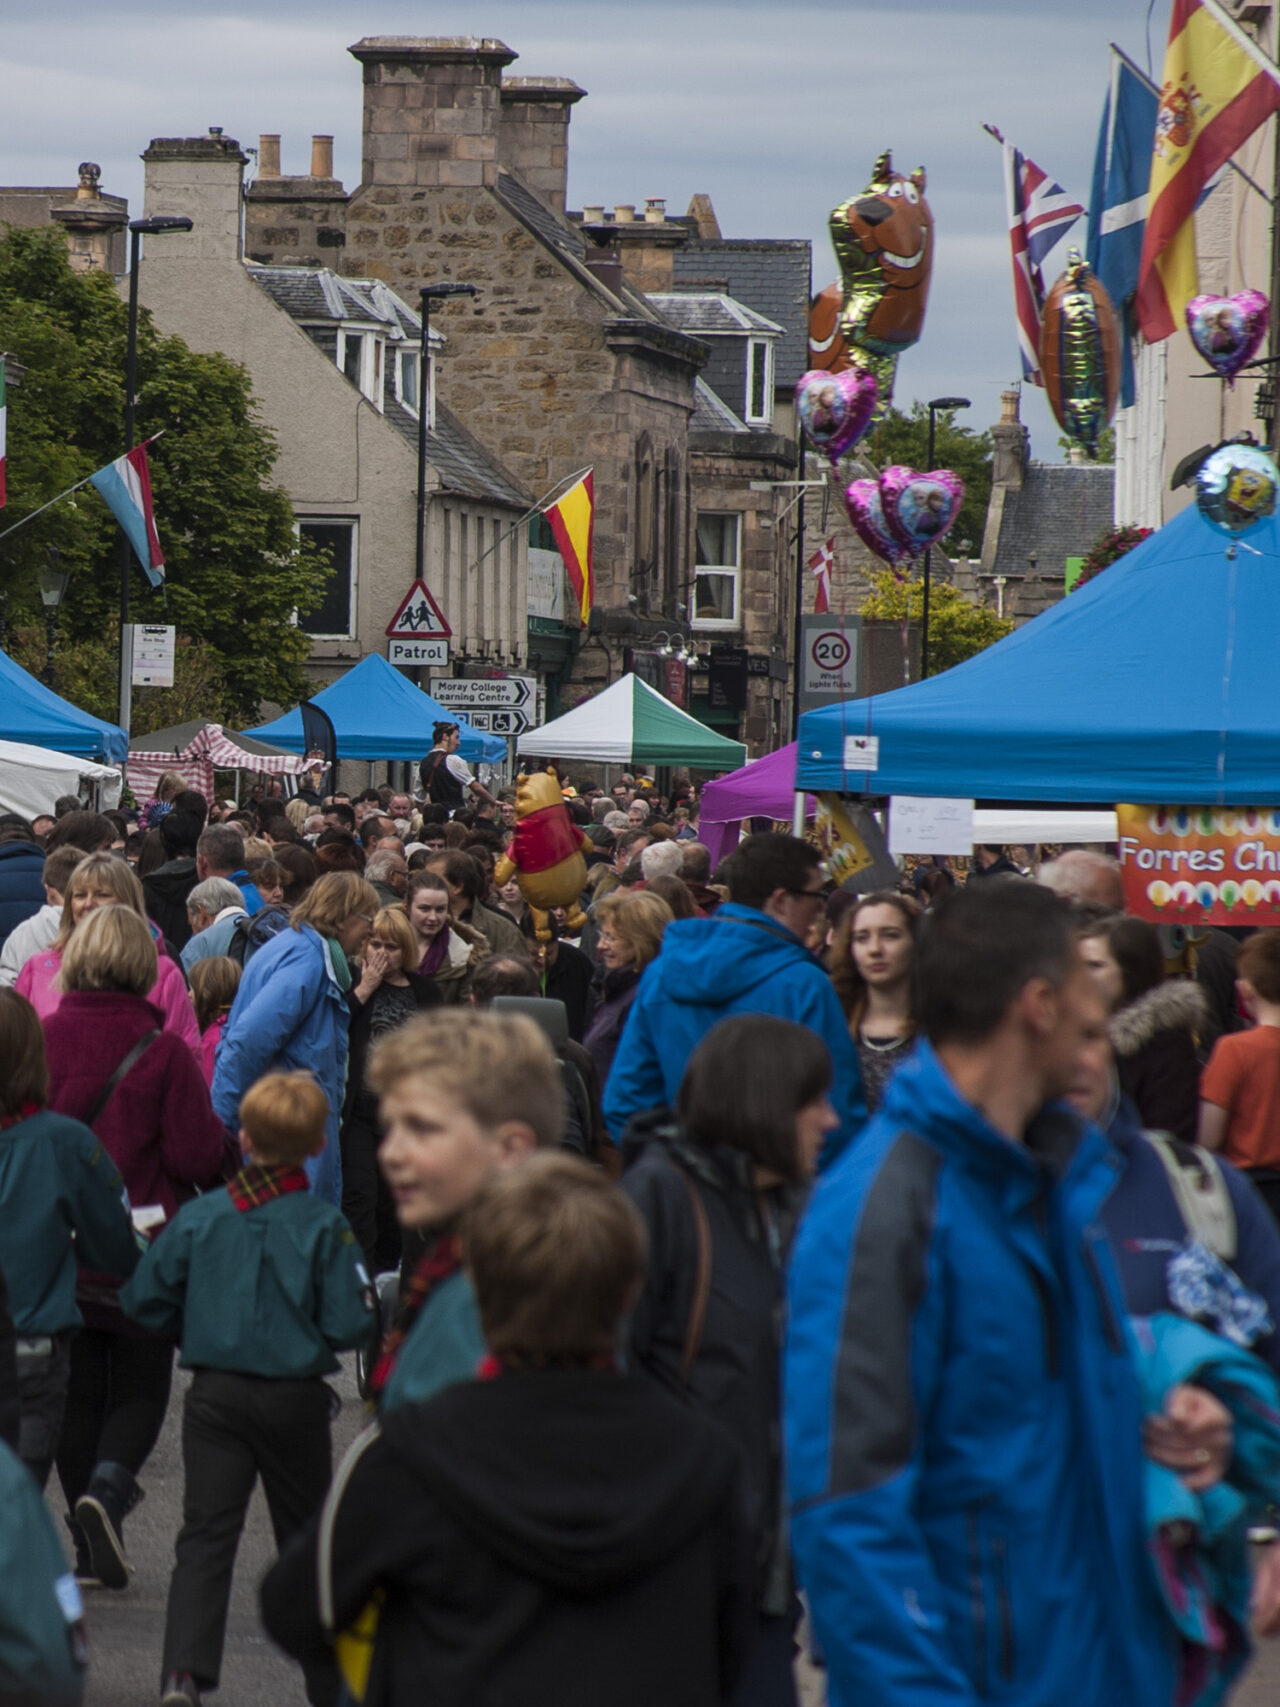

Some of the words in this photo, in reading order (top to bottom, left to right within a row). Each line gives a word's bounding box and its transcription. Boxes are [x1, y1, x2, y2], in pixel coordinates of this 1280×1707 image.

[393, 645, 443, 660] Patrol
[818, 643, 844, 659] 20
[437, 682, 468, 693] Moray
[470, 682, 508, 693] College
[433, 692, 475, 703] Learning
[477, 692, 512, 702] Centre
[1118, 836, 1226, 872] Forres
[1234, 840, 1280, 873] Ch
